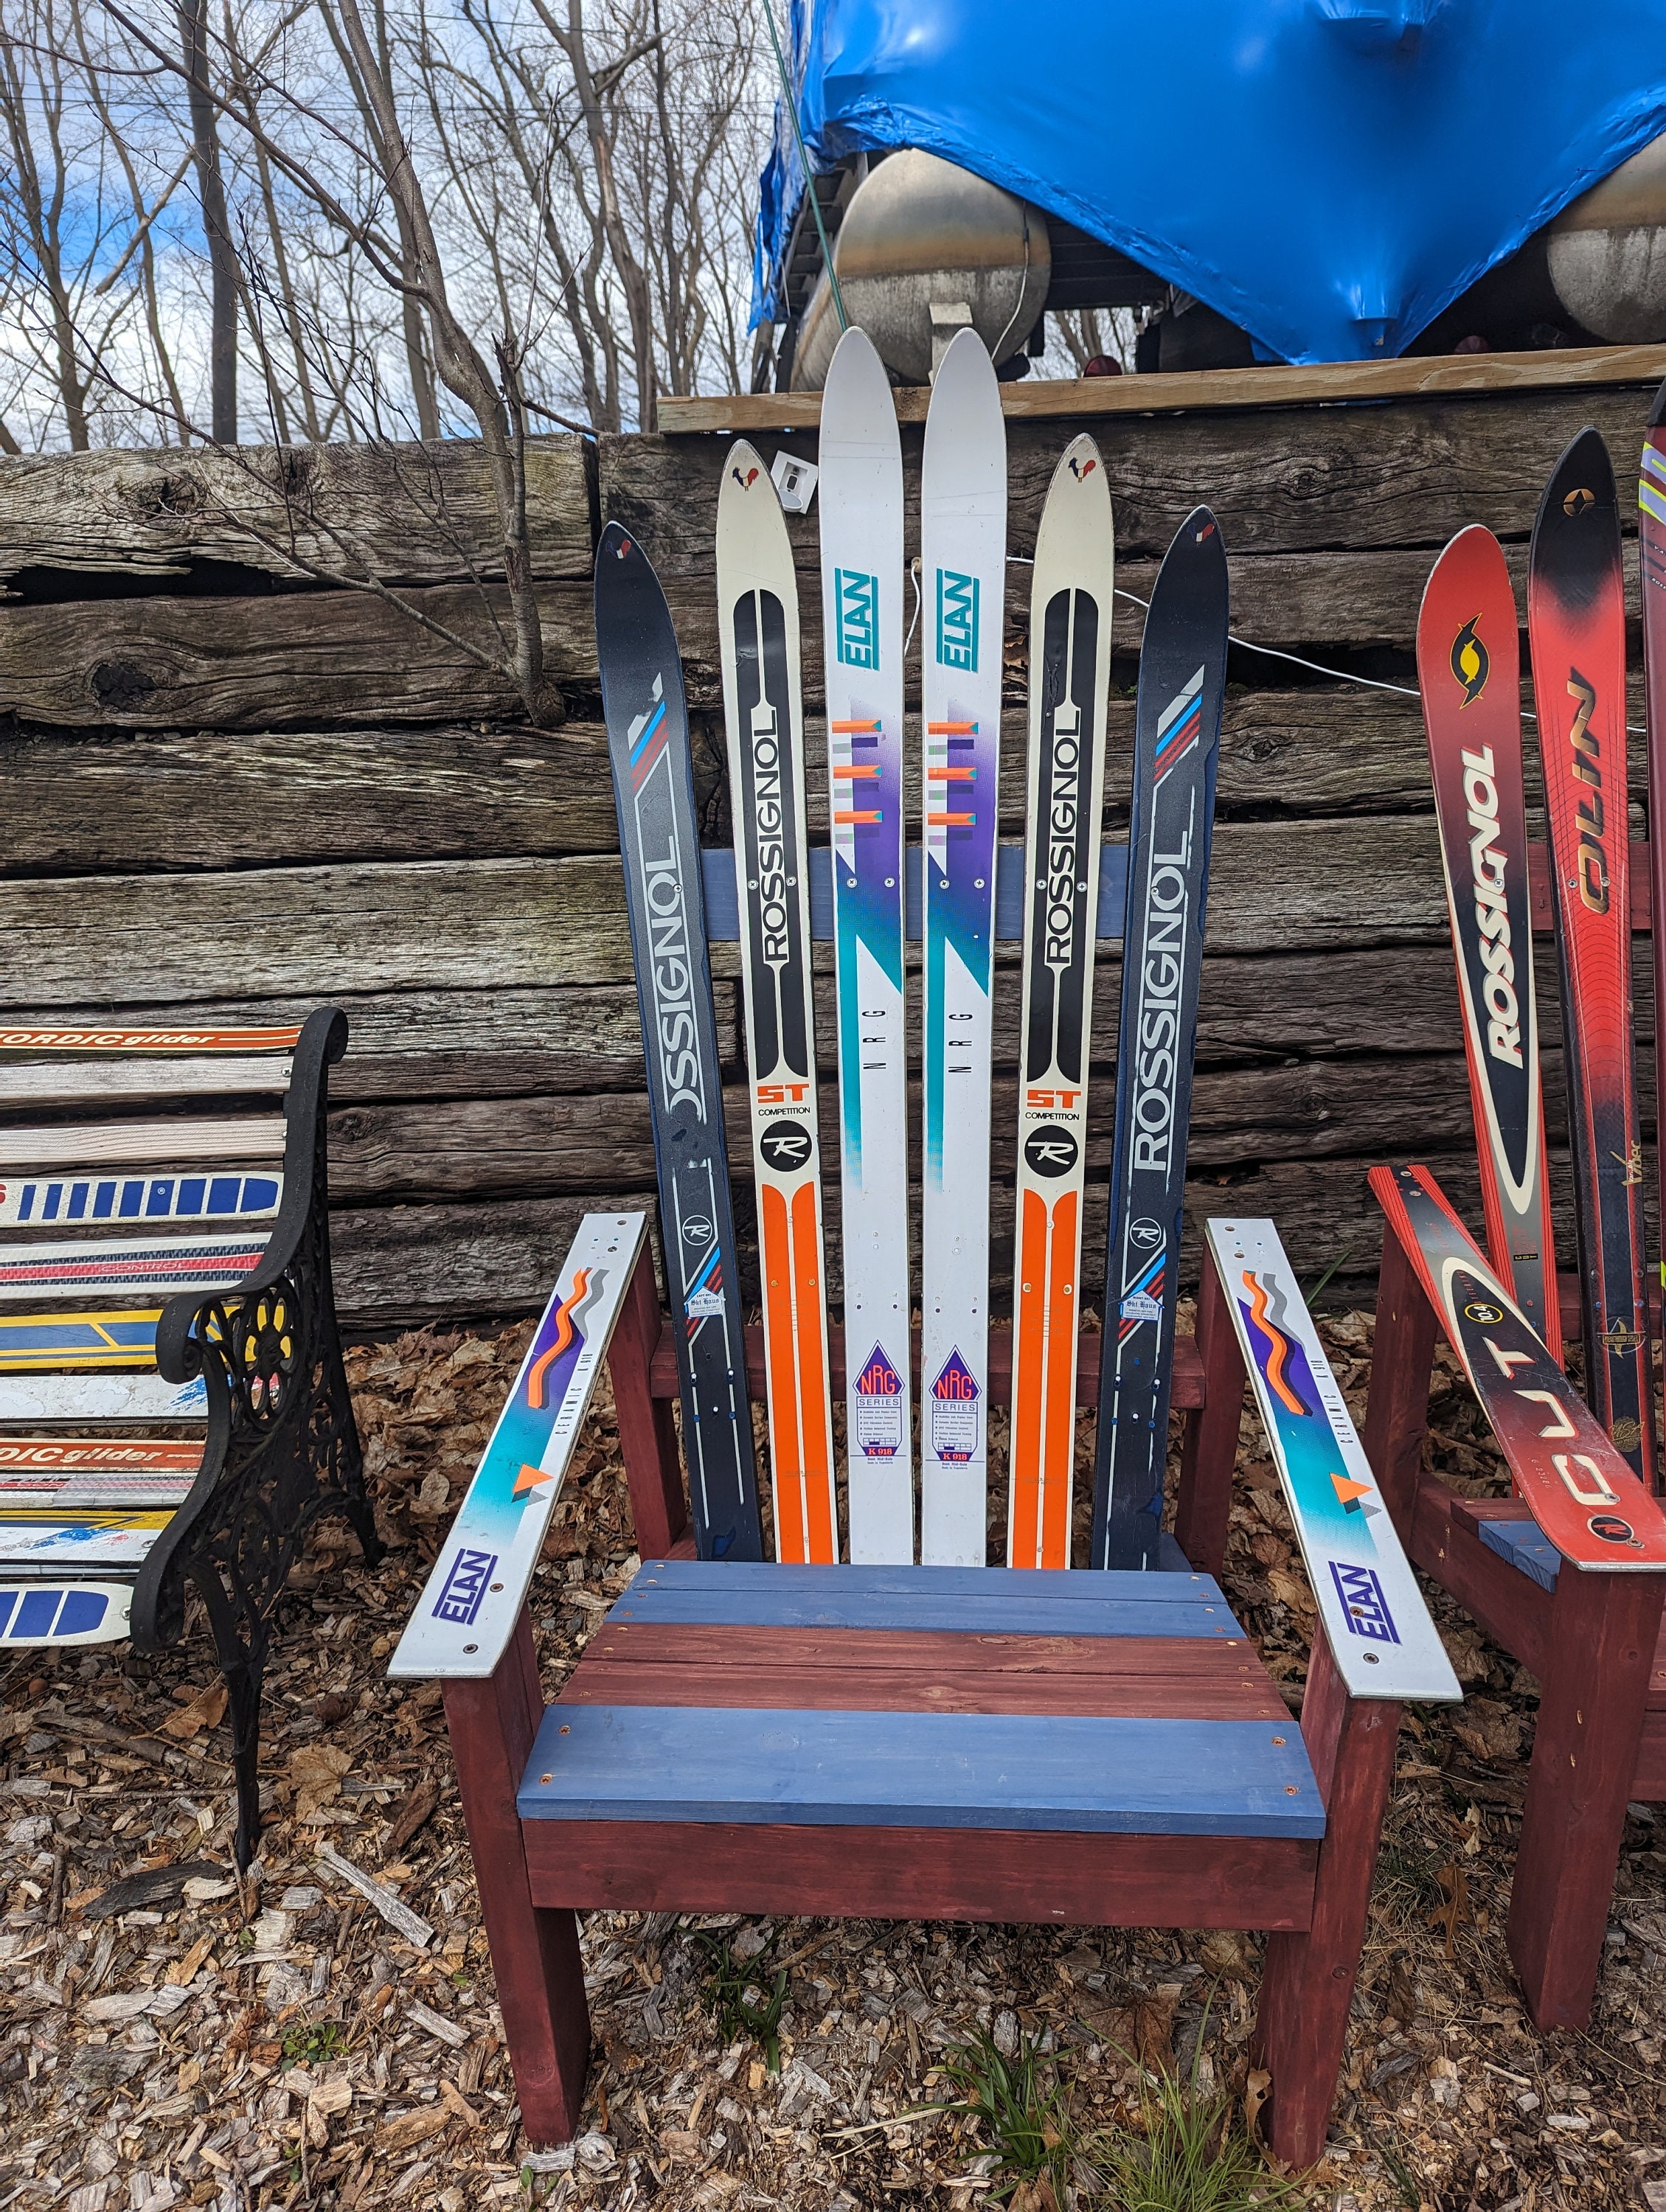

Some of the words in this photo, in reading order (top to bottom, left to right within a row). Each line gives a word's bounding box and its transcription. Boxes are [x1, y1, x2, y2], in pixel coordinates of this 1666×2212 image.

[843, 569, 872, 669] ELAN
[944, 570, 973, 672] ELAN
[1567, 675, 1608, 914] OLIN
[754, 709, 788, 961] ROSSIGNOL
[1047, 710, 1080, 964] ROSSIGNOL
[1462, 742, 1523, 1069] ROSSIGNOL
[646, 835, 707, 1168] OSSIGNOL
[1134, 831, 1188, 1172] ROSSIGNOL
[0, 1034, 123, 1045] ORDIC
[121, 1034, 215, 1045] glider
[757, 1084, 809, 1103] ST
[758, 1107, 811, 1116] COMPETITION
[1025, 1112, 1080, 1121] COMPETITION
[1027, 1089, 1081, 1108] ST
[102, 1263, 185, 1271] CONTROL
[1474, 1305, 1494, 1321] 10.4
[861, 1365, 895, 1394] NRG
[937, 1369, 972, 1399] NRG
[555, 1386, 583, 1435] CERAMIC
[1324, 1394, 1353, 1443] CERAMIC
[1482, 1336, 1621, 1506] CUT
[60, 1448, 162, 1463] glider
[869, 1447, 875, 1455] K
[878, 1447, 892, 1455] 918
[943, 1453, 951, 1461] K
[439, 1550, 492, 1625] ELAN
[1336, 1562, 1388, 1643] ELAN
